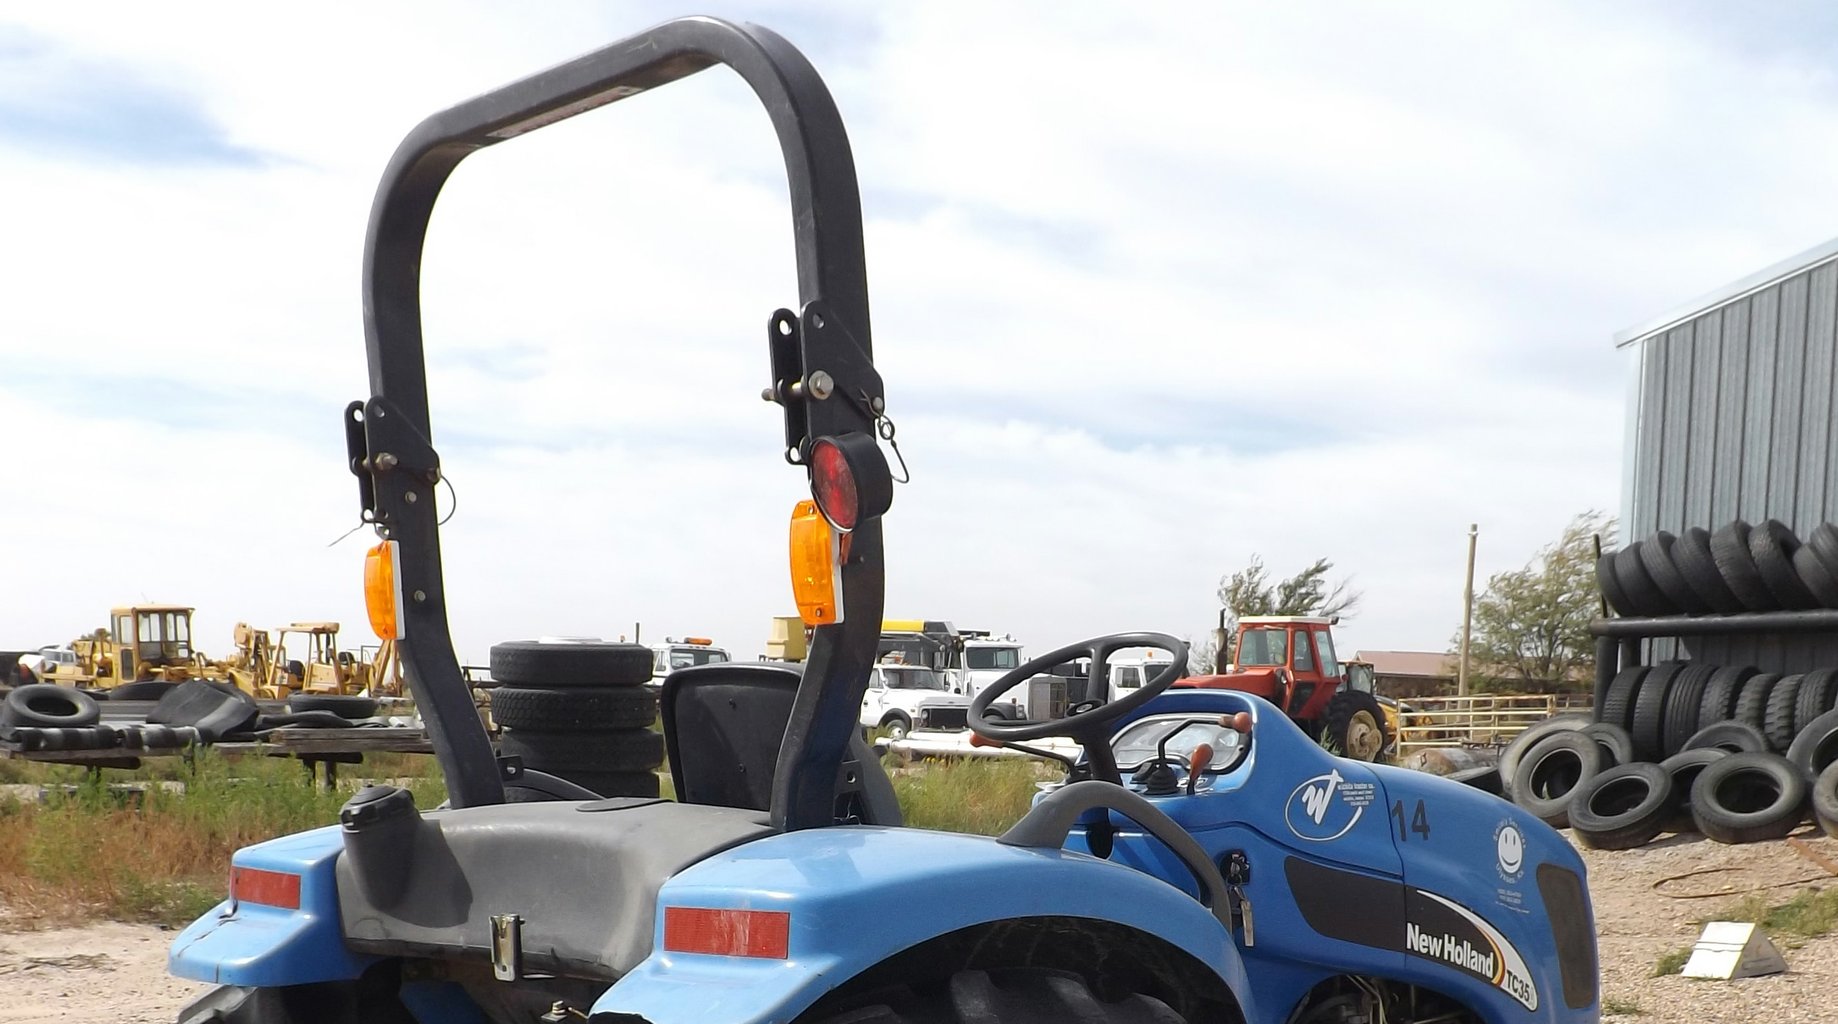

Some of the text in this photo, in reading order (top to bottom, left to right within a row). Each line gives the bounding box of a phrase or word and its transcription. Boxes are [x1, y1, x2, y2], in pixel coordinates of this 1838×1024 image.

[1391, 799, 1431, 841] 14
[1406, 922, 1494, 978] New Holland
